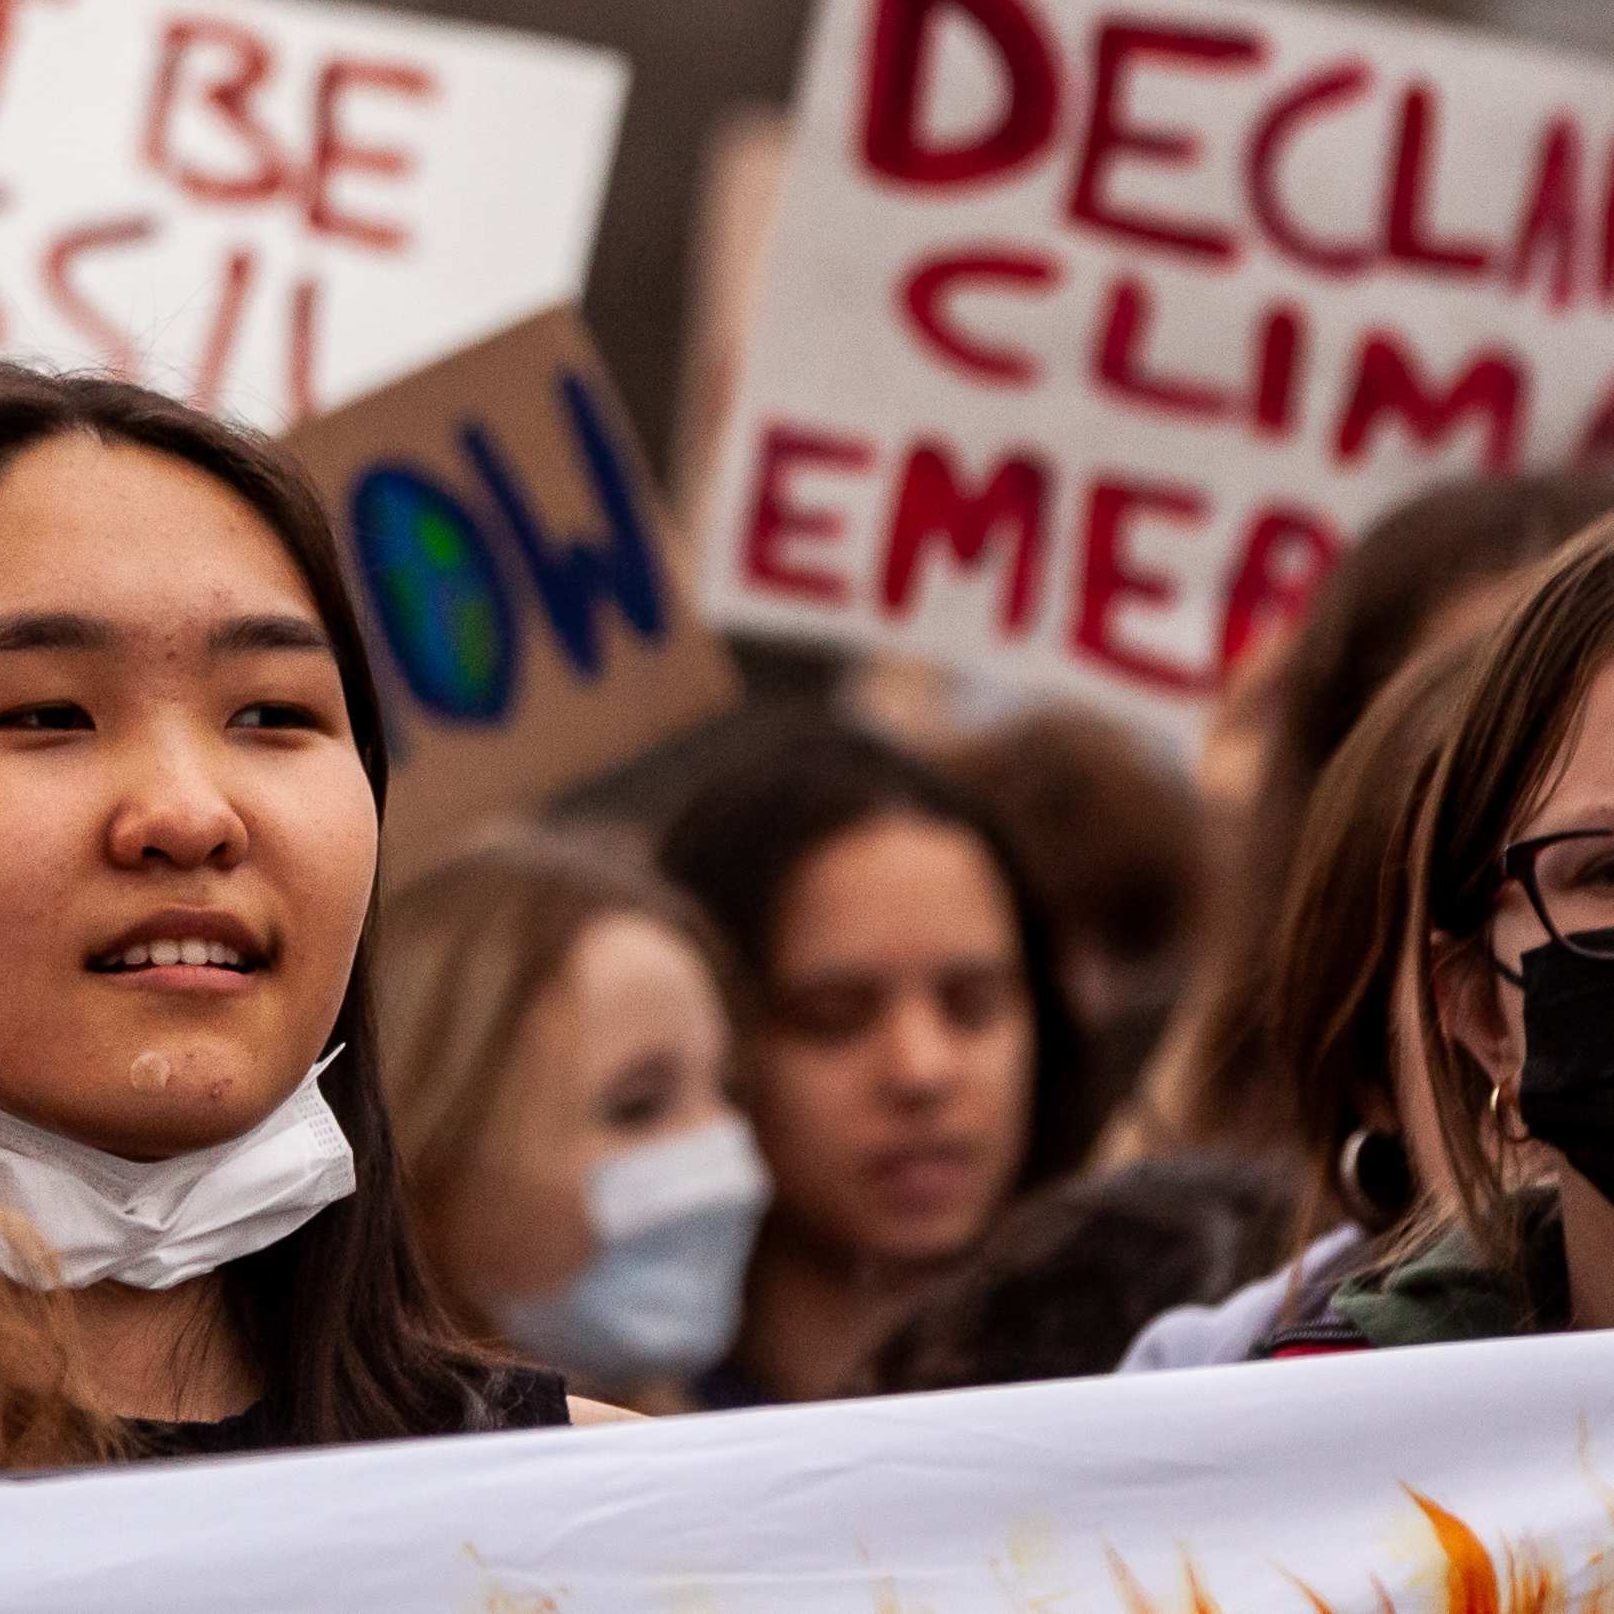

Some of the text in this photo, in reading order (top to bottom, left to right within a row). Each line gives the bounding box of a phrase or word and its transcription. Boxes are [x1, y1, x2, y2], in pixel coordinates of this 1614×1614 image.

[138, 8, 441, 258] BE
[892, 244, 1614, 478] CLIM
[348, 369, 669, 770] OW
